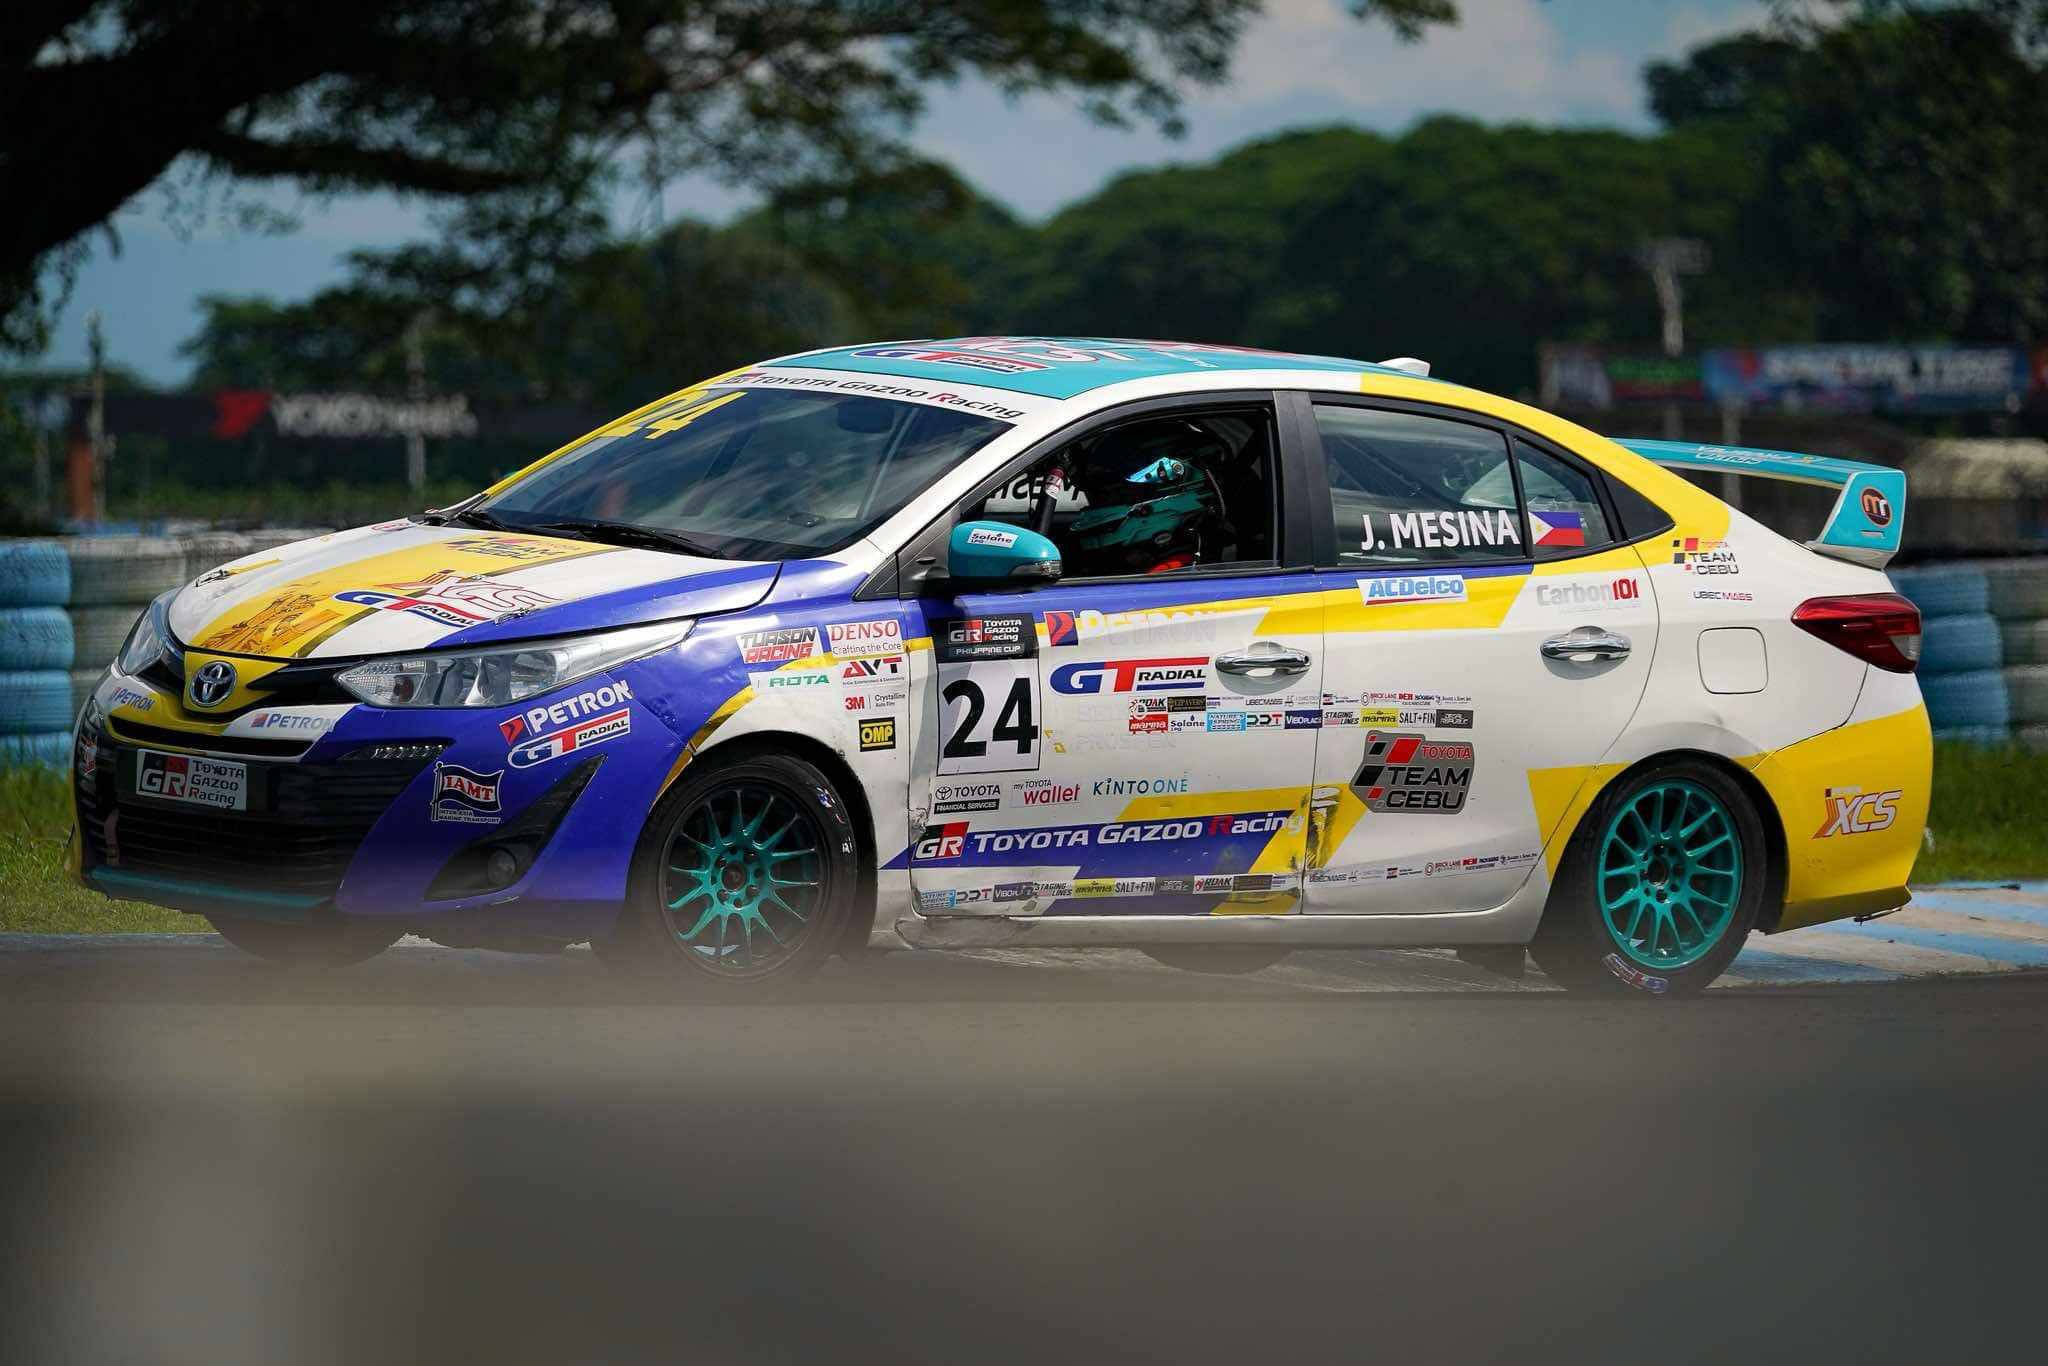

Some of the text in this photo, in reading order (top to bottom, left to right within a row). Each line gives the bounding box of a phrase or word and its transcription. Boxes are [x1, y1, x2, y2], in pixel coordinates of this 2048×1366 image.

[754, 374, 837, 387] TOYOTA
[838, 380, 929, 399] GAZOO
[928, 391, 1026, 419] Racing
[597, 389, 749, 440] 24
[971, 534, 1013, 544] Solane
[1360, 510, 1520, 552] J. MESINA
[1687, 552, 1736, 563] TEAM
[1696, 565, 1739, 575] CEBU
[1367, 577, 1464, 597] ACDelco
[416, 605, 475, 626] RADIAL
[983, 619, 1022, 628] TOYOTA
[831, 620, 899, 641] DENSO
[950, 629, 982, 642] GR
[984, 627, 1019, 635] GAZOO
[984, 634, 1019, 643] Racing
[744, 643, 814, 662] RACING
[832, 641, 901, 656] Crafting the Core
[956, 645, 1021, 656] PHILIPPINE CUP
[843, 656, 902, 678] AVT
[1050, 656, 1206, 695] GT RADIAL
[769, 675, 830, 688] ROTA
[118, 688, 155, 711] PETRON
[527, 679, 633, 734] PETRON
[845, 696, 865, 710] 3M
[942, 677, 1039, 759] 24
[1170, 719, 1206, 727] Solane
[1324, 711, 1354, 719] STAGING
[1340, 717, 1360, 725] LINES
[1361, 714, 1397, 724] marina
[1399, 712, 1436, 724] SALT+FIN
[860, 725, 894, 744] OMP
[508, 719, 629, 769] GT RADIAL
[1421, 744, 1471, 759] TOYOTA
[192, 760, 245, 779] TOYOTA
[1386, 766, 1468, 787] TEAM
[141, 768, 187, 799] GR
[190, 774, 239, 791] GAZOO
[446, 776, 494, 801] IAMT
[954, 784, 1001, 798] TOYOTA
[1013, 779, 1052, 791] my TOYOTA
[1153, 779, 1190, 794] ONE
[188, 788, 236, 809] Racing
[1023, 784, 1081, 806] wallet
[1386, 791, 1465, 810] CEBU
[936, 800, 998, 812] FINANCIAL SERVICES
[974, 811, 1304, 852] TOYOTA GAZOO Racing
[915, 836, 963, 861] GR
[1051, 889, 1073, 898] LINES
[1115, 880, 1154, 895] SALT+FIN
